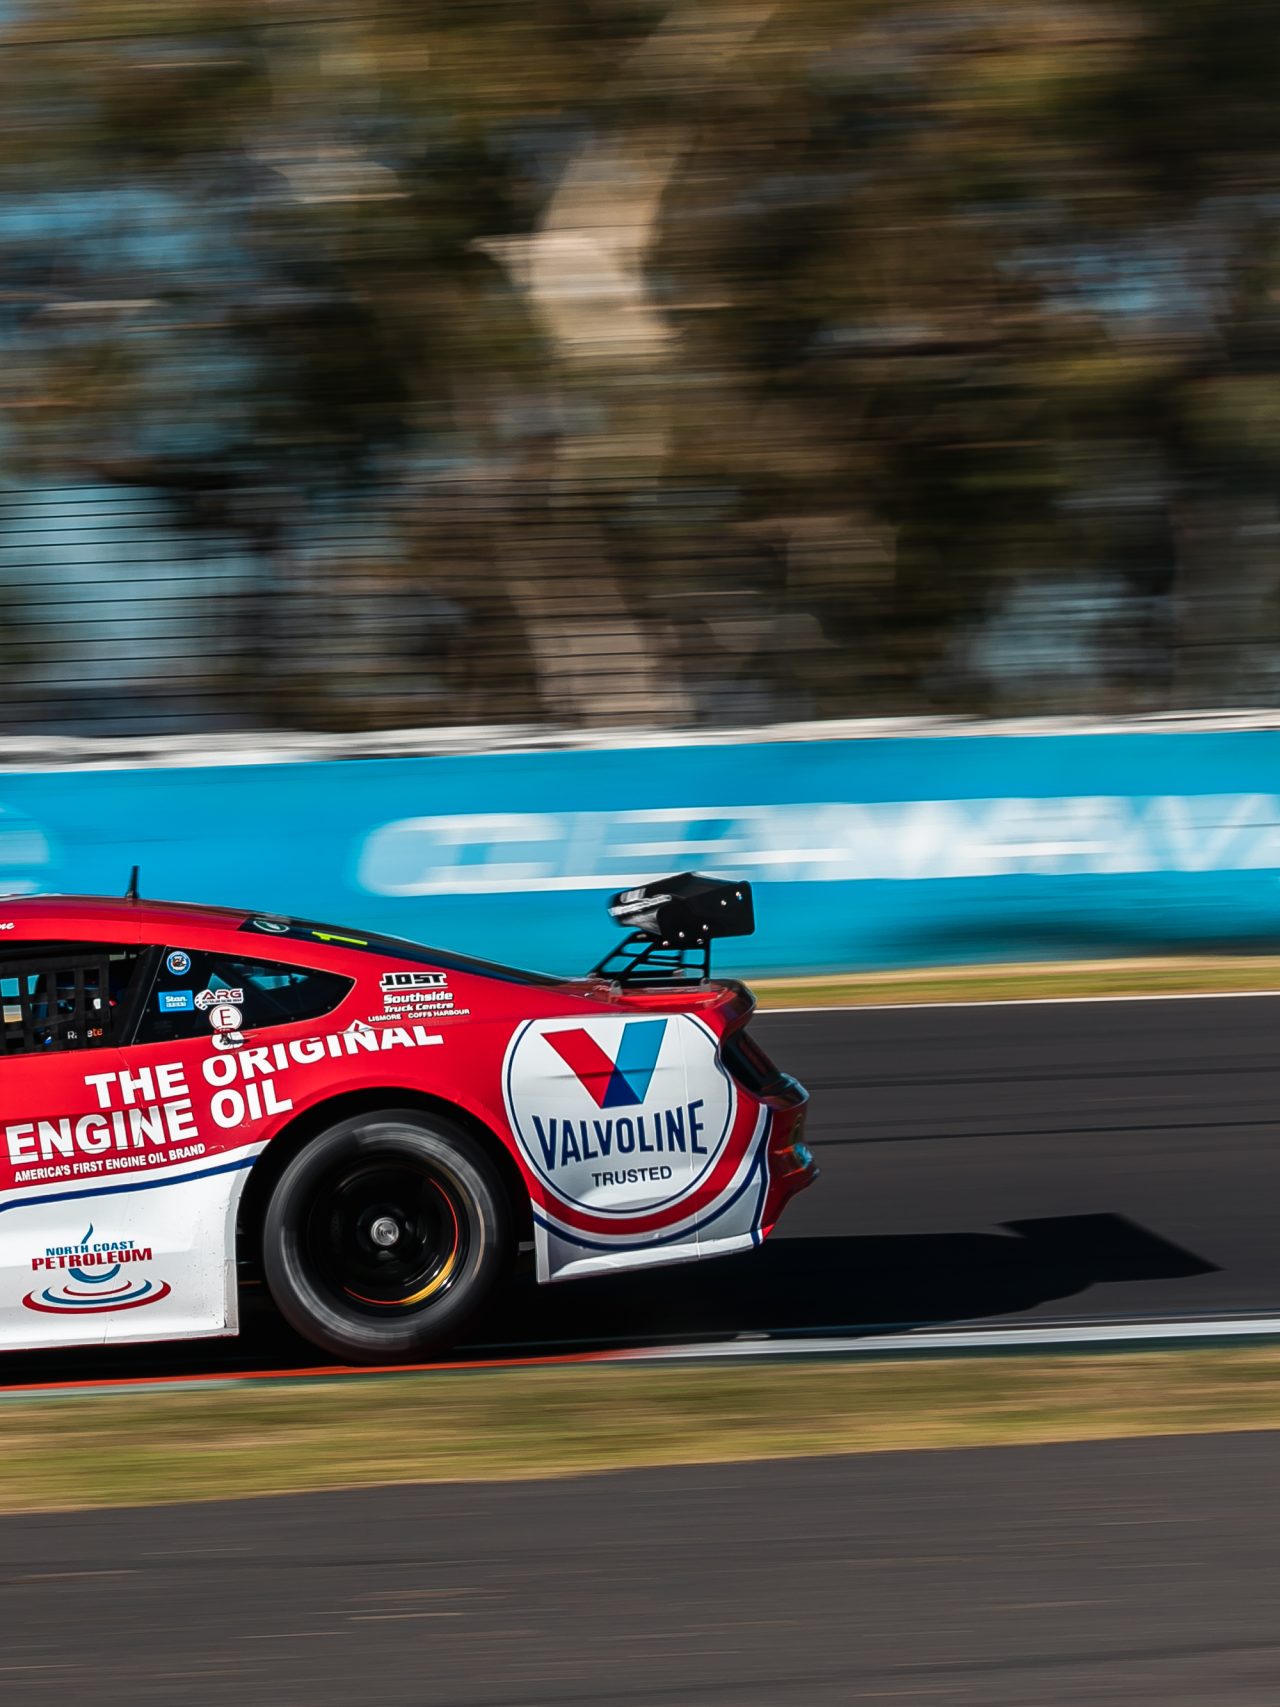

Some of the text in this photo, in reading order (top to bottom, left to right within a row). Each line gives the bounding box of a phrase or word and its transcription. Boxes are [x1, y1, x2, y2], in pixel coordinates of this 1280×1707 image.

[380, 972, 446, 987] JOST
[202, 989, 242, 1000] ARG
[383, 991, 454, 1004] Southside
[367, 1008, 470, 1022] LISMORE COFFS HARBOUR
[383, 1002, 455, 1013] Truck Centre
[219, 1008, 233, 1026] E
[84, 1025, 445, 1110] THE ORIGINAL
[5, 1078, 293, 1166] ENGINE OIL
[531, 1098, 708, 1171] VALVOLINE
[14, 1143, 206, 1183] AMERICA'S FIRST ENGINE OIL BRAND
[591, 1165, 673, 1187] TRUSTED
[45, 1240, 135, 1257] NORTH COAST
[31, 1247, 153, 1271] PETROLEUM
